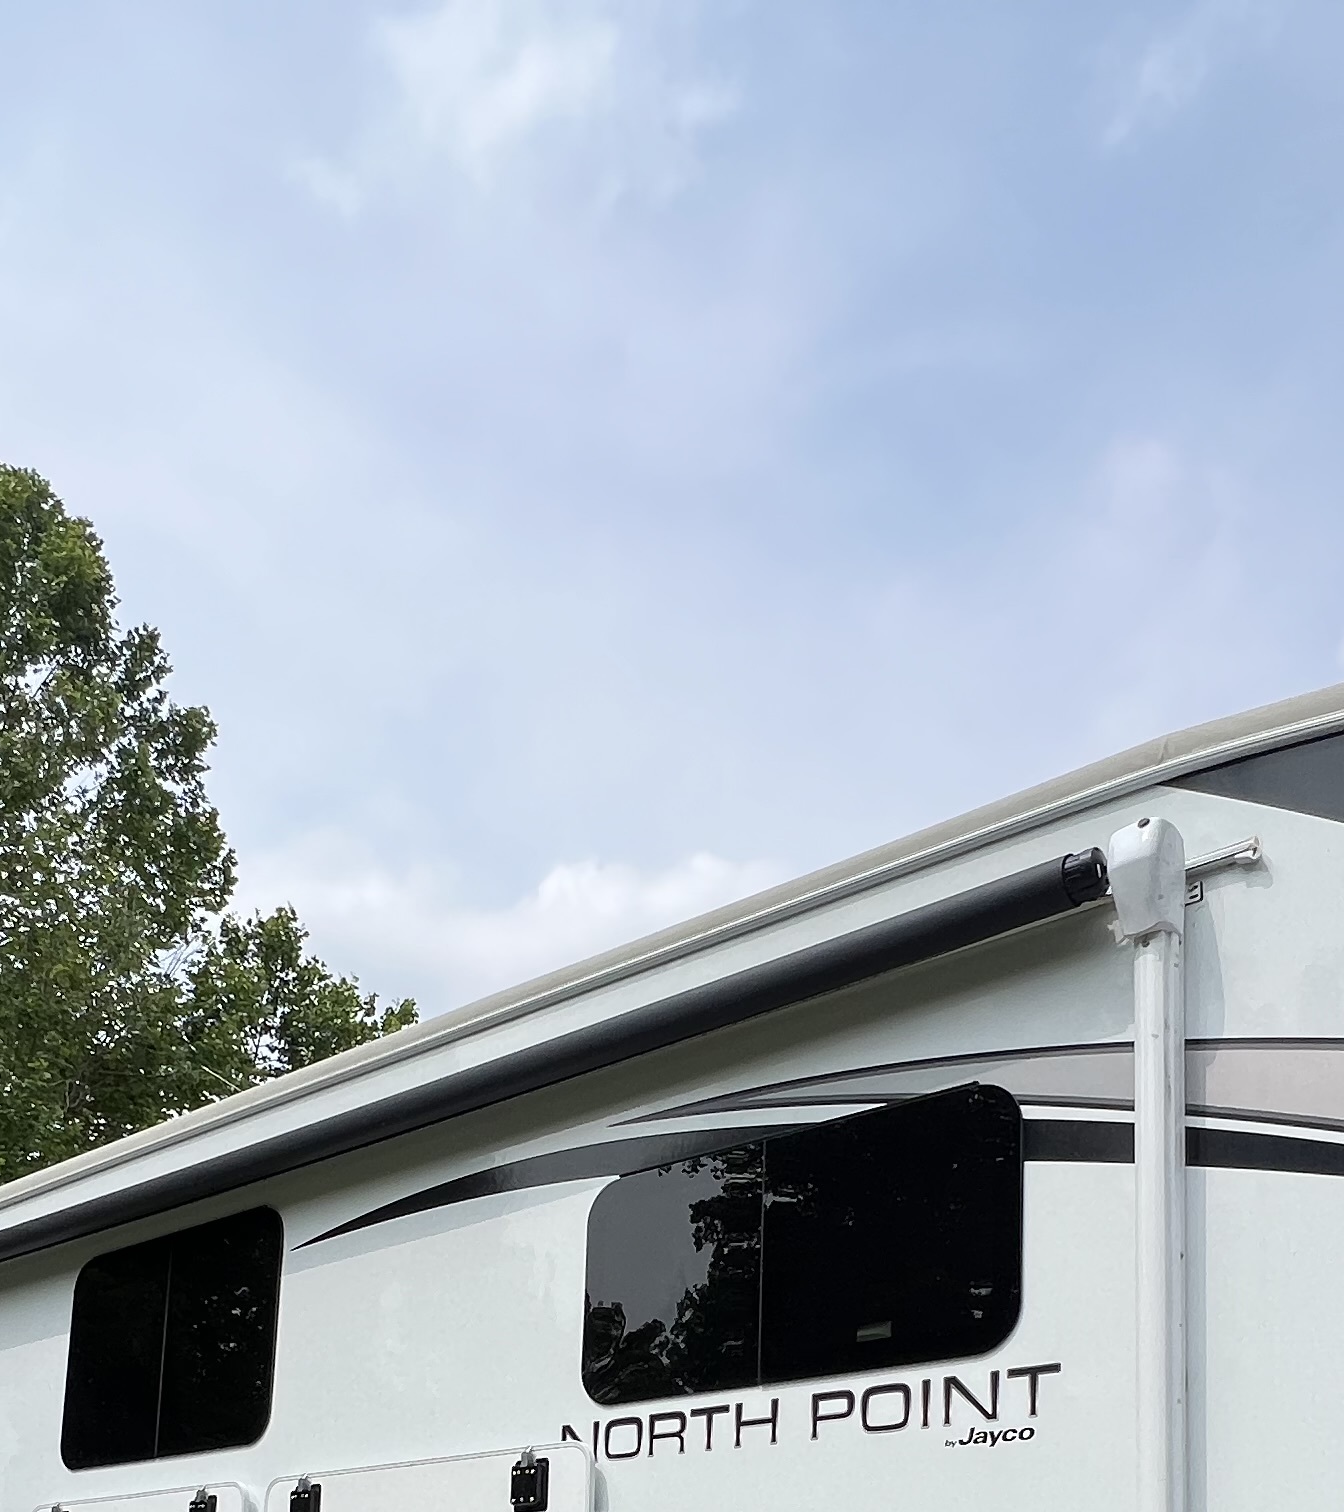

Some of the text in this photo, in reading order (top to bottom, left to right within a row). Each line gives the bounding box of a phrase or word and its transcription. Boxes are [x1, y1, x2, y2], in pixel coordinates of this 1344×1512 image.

[561, 1363, 1062, 1461] NORTH POINT
[944, 1427, 1036, 1448] by Jayco
